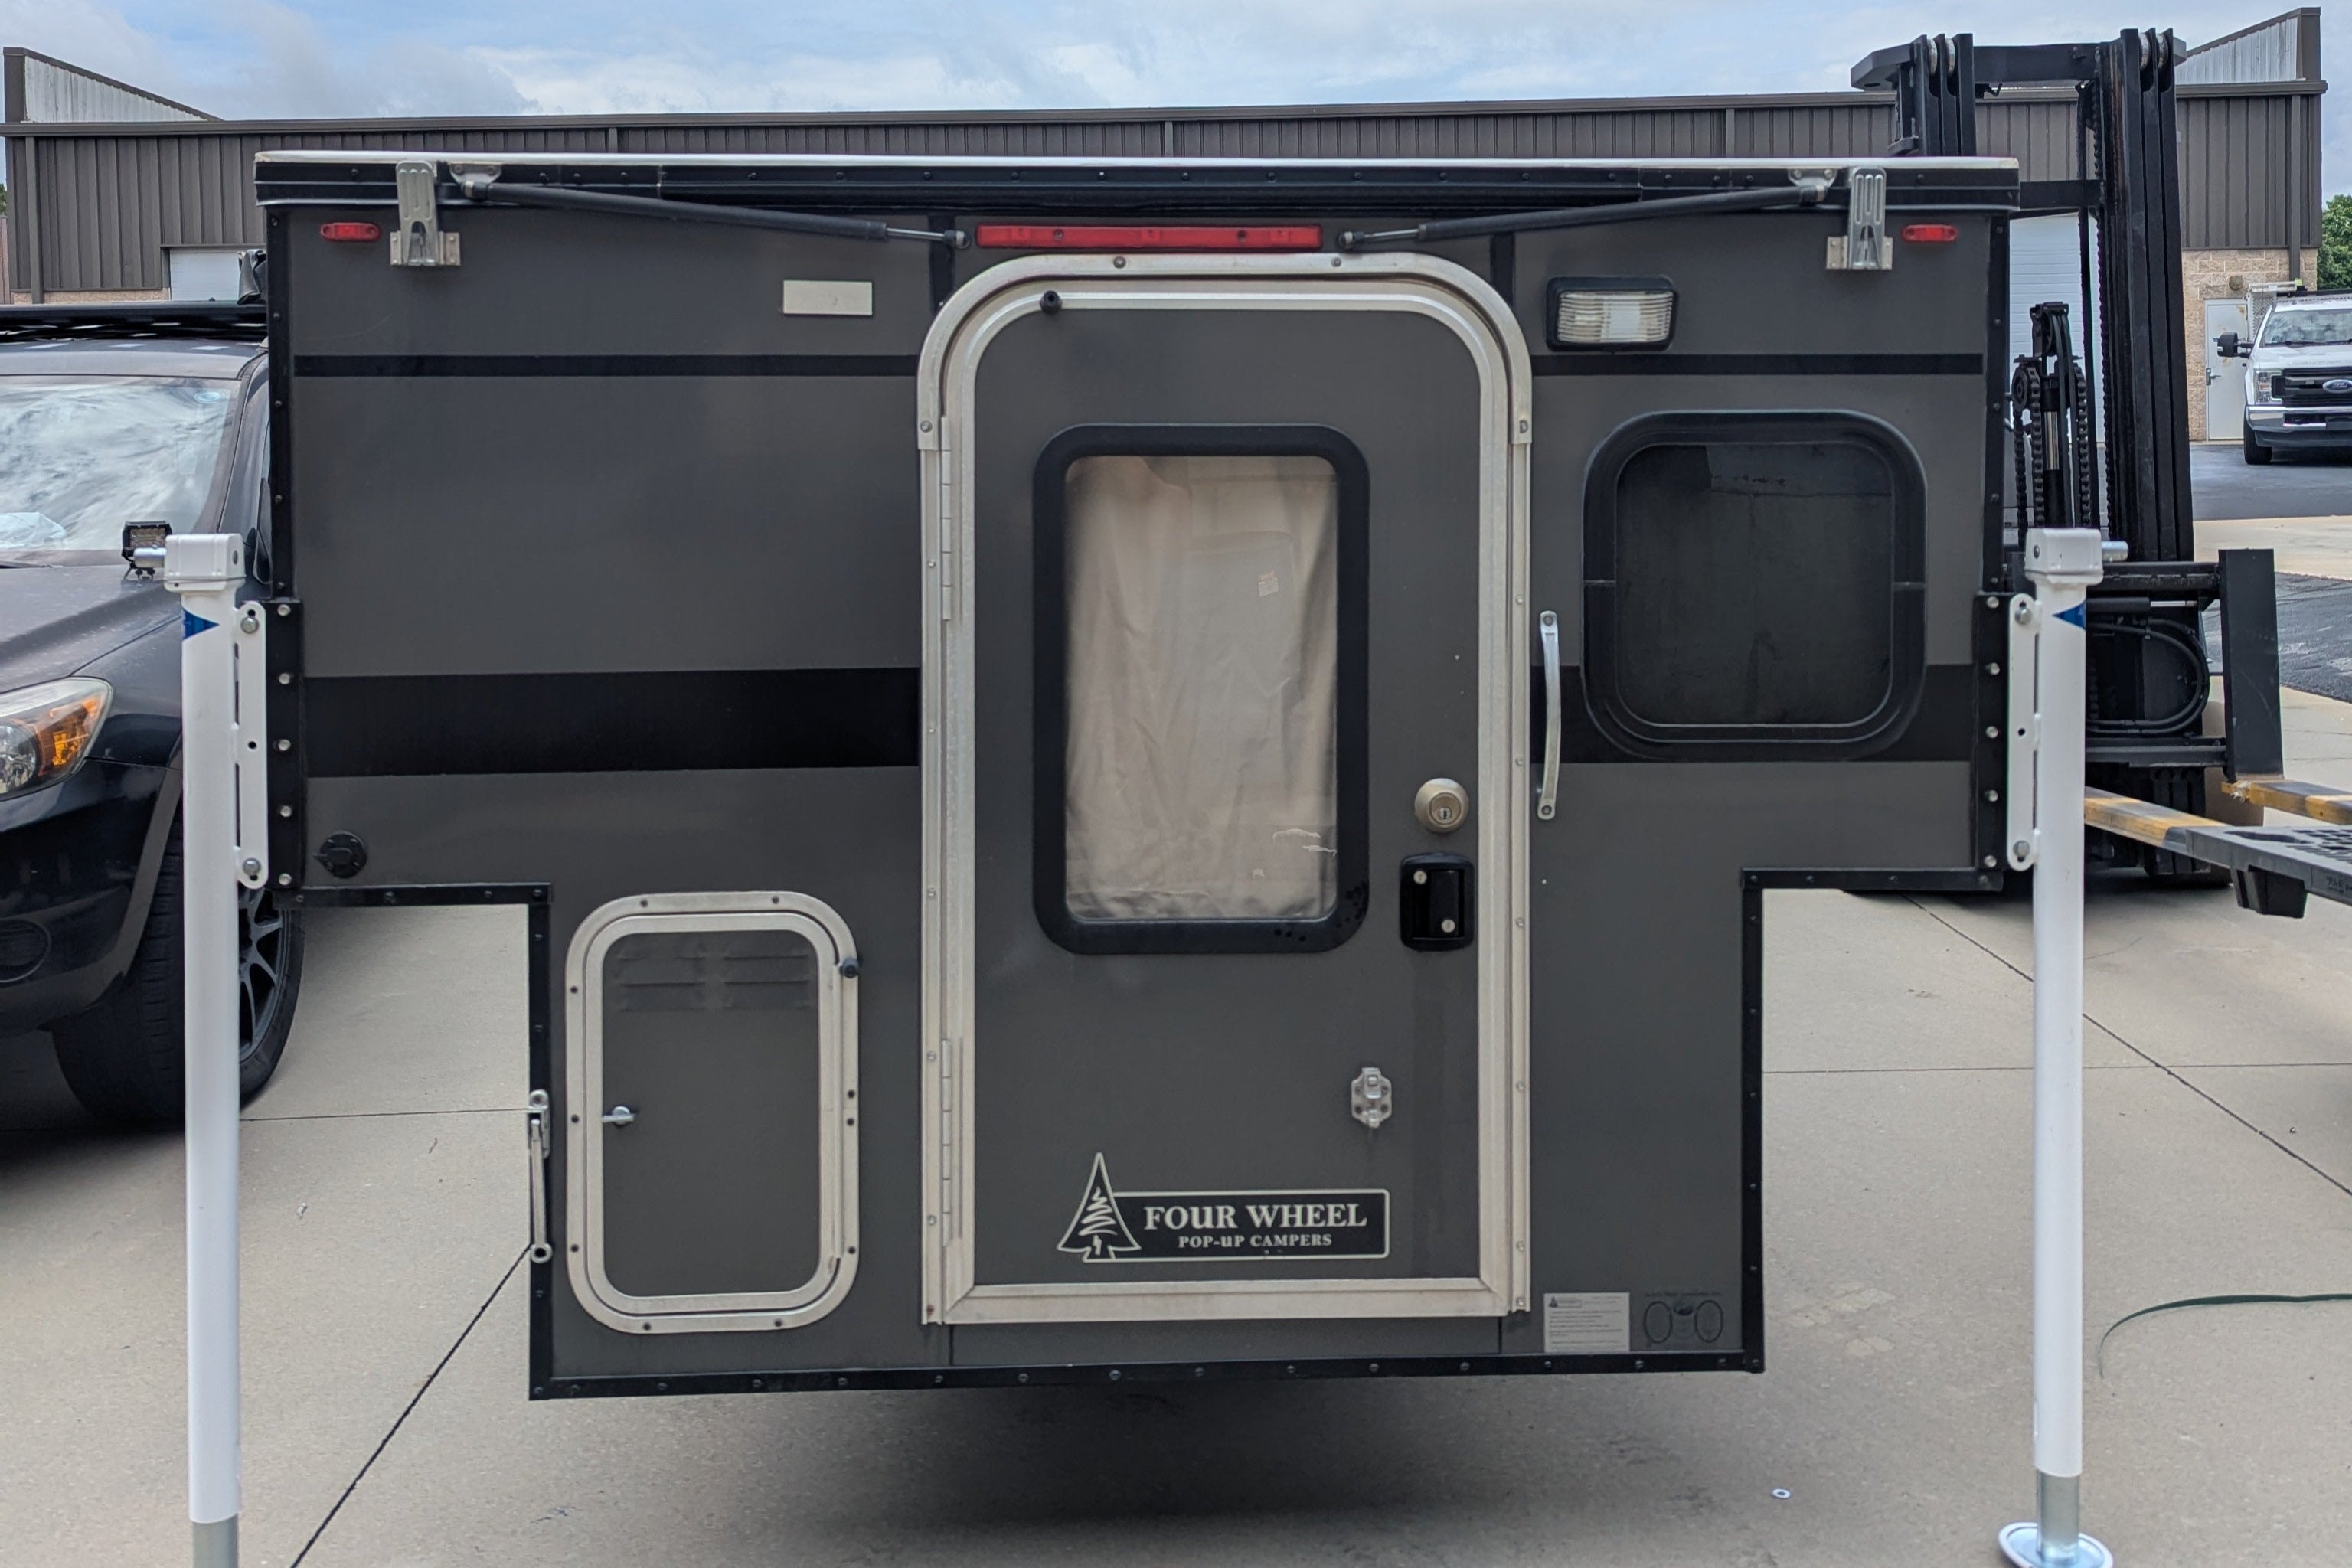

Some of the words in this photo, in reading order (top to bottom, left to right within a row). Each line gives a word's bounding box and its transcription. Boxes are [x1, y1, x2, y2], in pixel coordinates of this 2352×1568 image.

[1144, 1204, 1238, 1230] FOUR
[1245, 1203, 1367, 1228] WHEEL
[1178, 1235, 1245, 1248] POP-UP
[1250, 1233, 1332, 1247] CAMPERS
